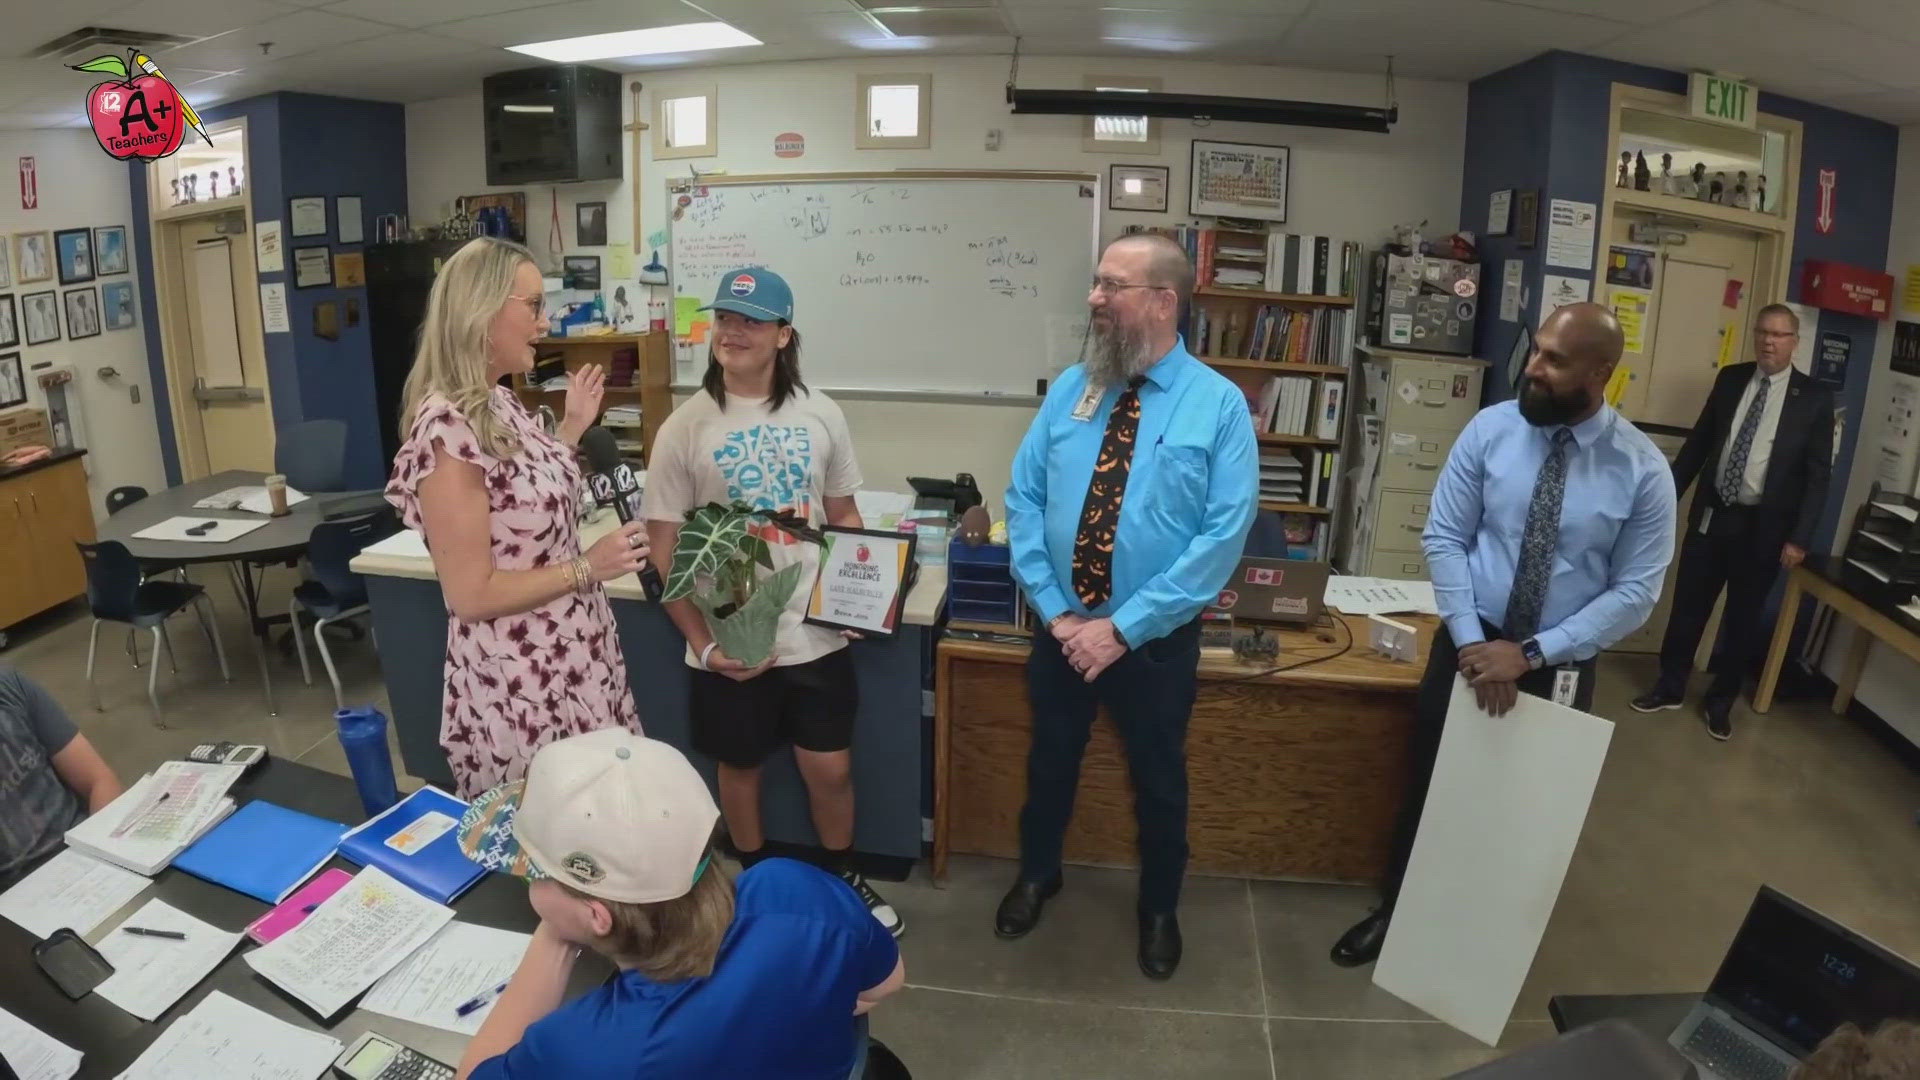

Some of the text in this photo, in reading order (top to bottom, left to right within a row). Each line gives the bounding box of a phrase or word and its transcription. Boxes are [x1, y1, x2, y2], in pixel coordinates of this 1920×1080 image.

[1705, 77, 1749, 122] EXIT
[716, 425, 811, 467] STATE
[838, 568, 881, 582] EXCELLENCE
[844, 561, 880, 573] HONORING
[1823, 953, 1856, 979] 12:26
